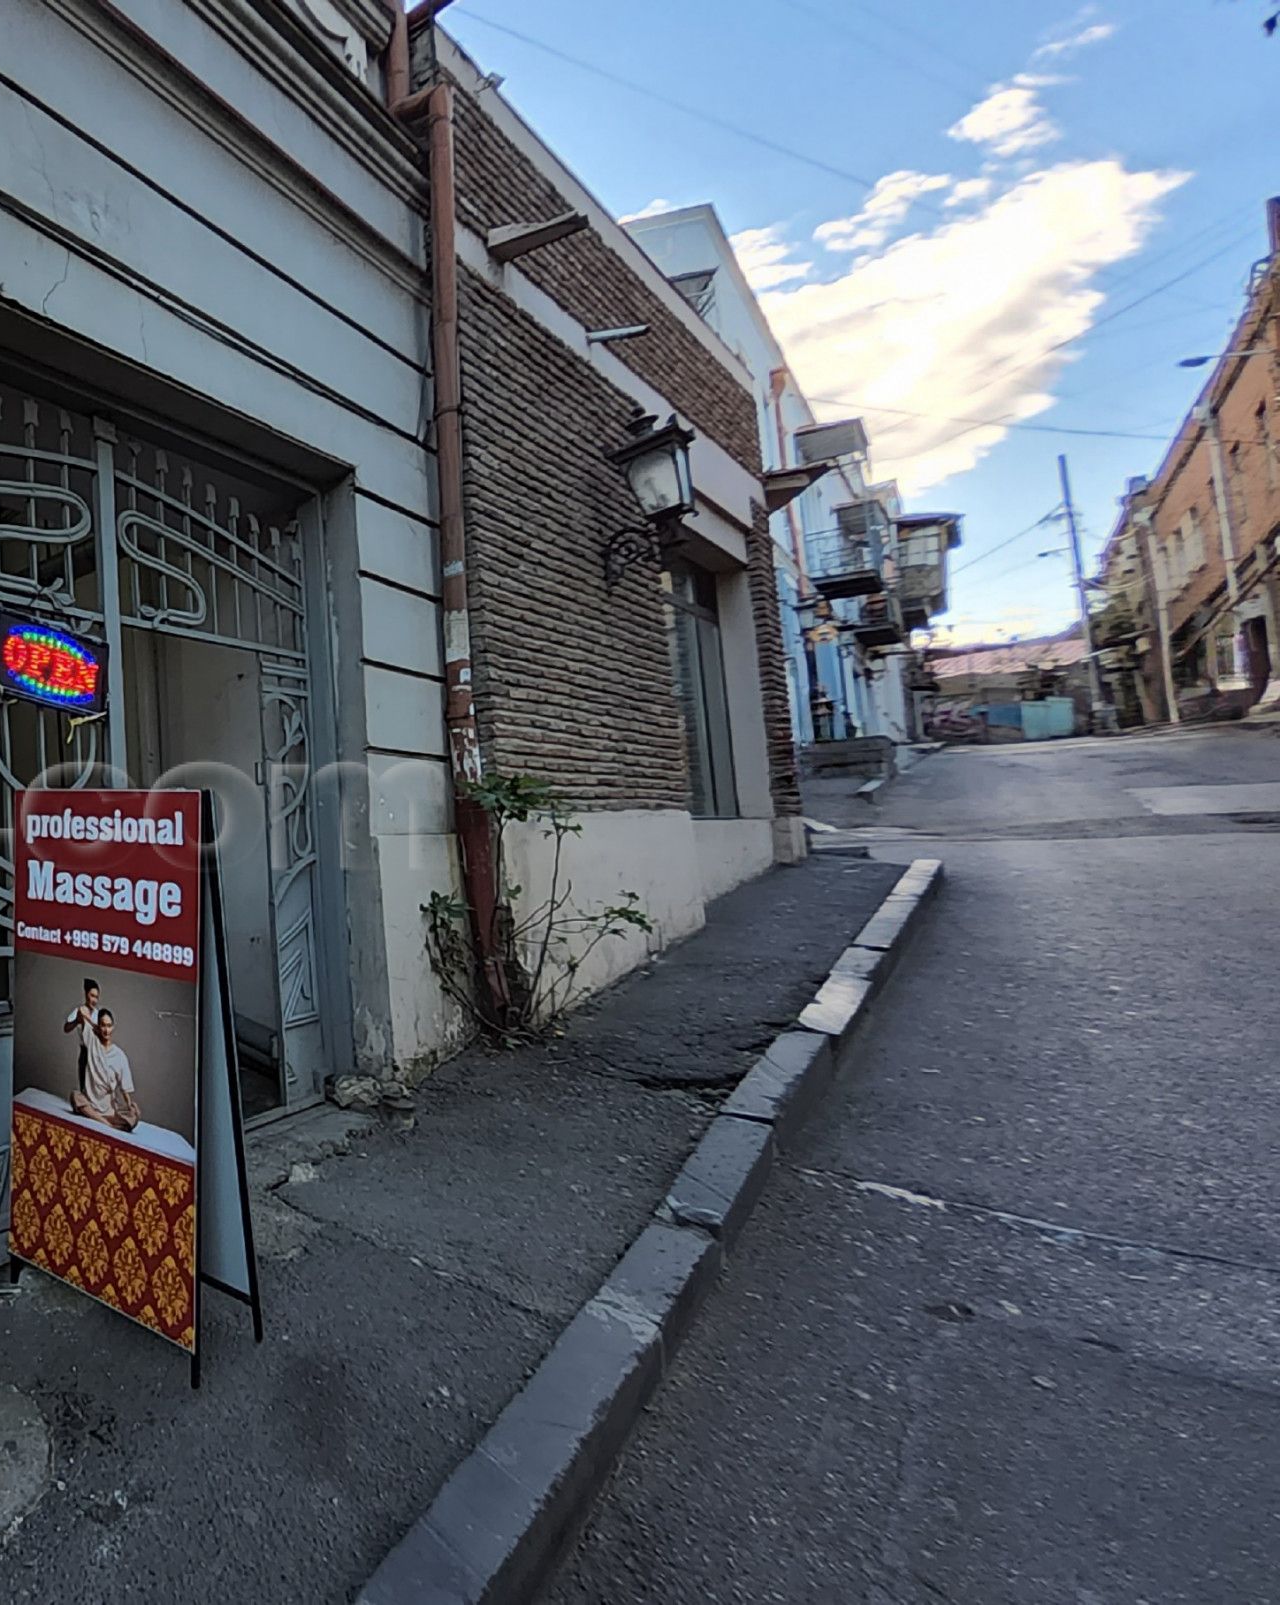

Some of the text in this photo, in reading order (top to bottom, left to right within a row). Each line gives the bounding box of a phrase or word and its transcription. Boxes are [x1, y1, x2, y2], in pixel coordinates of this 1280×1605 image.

[3, 635, 99, 693] OPEN
[25, 808, 184, 846] professional
[27, 859, 183, 926] Massage
[17, 921, 194, 967] Contact +995 579 448899
